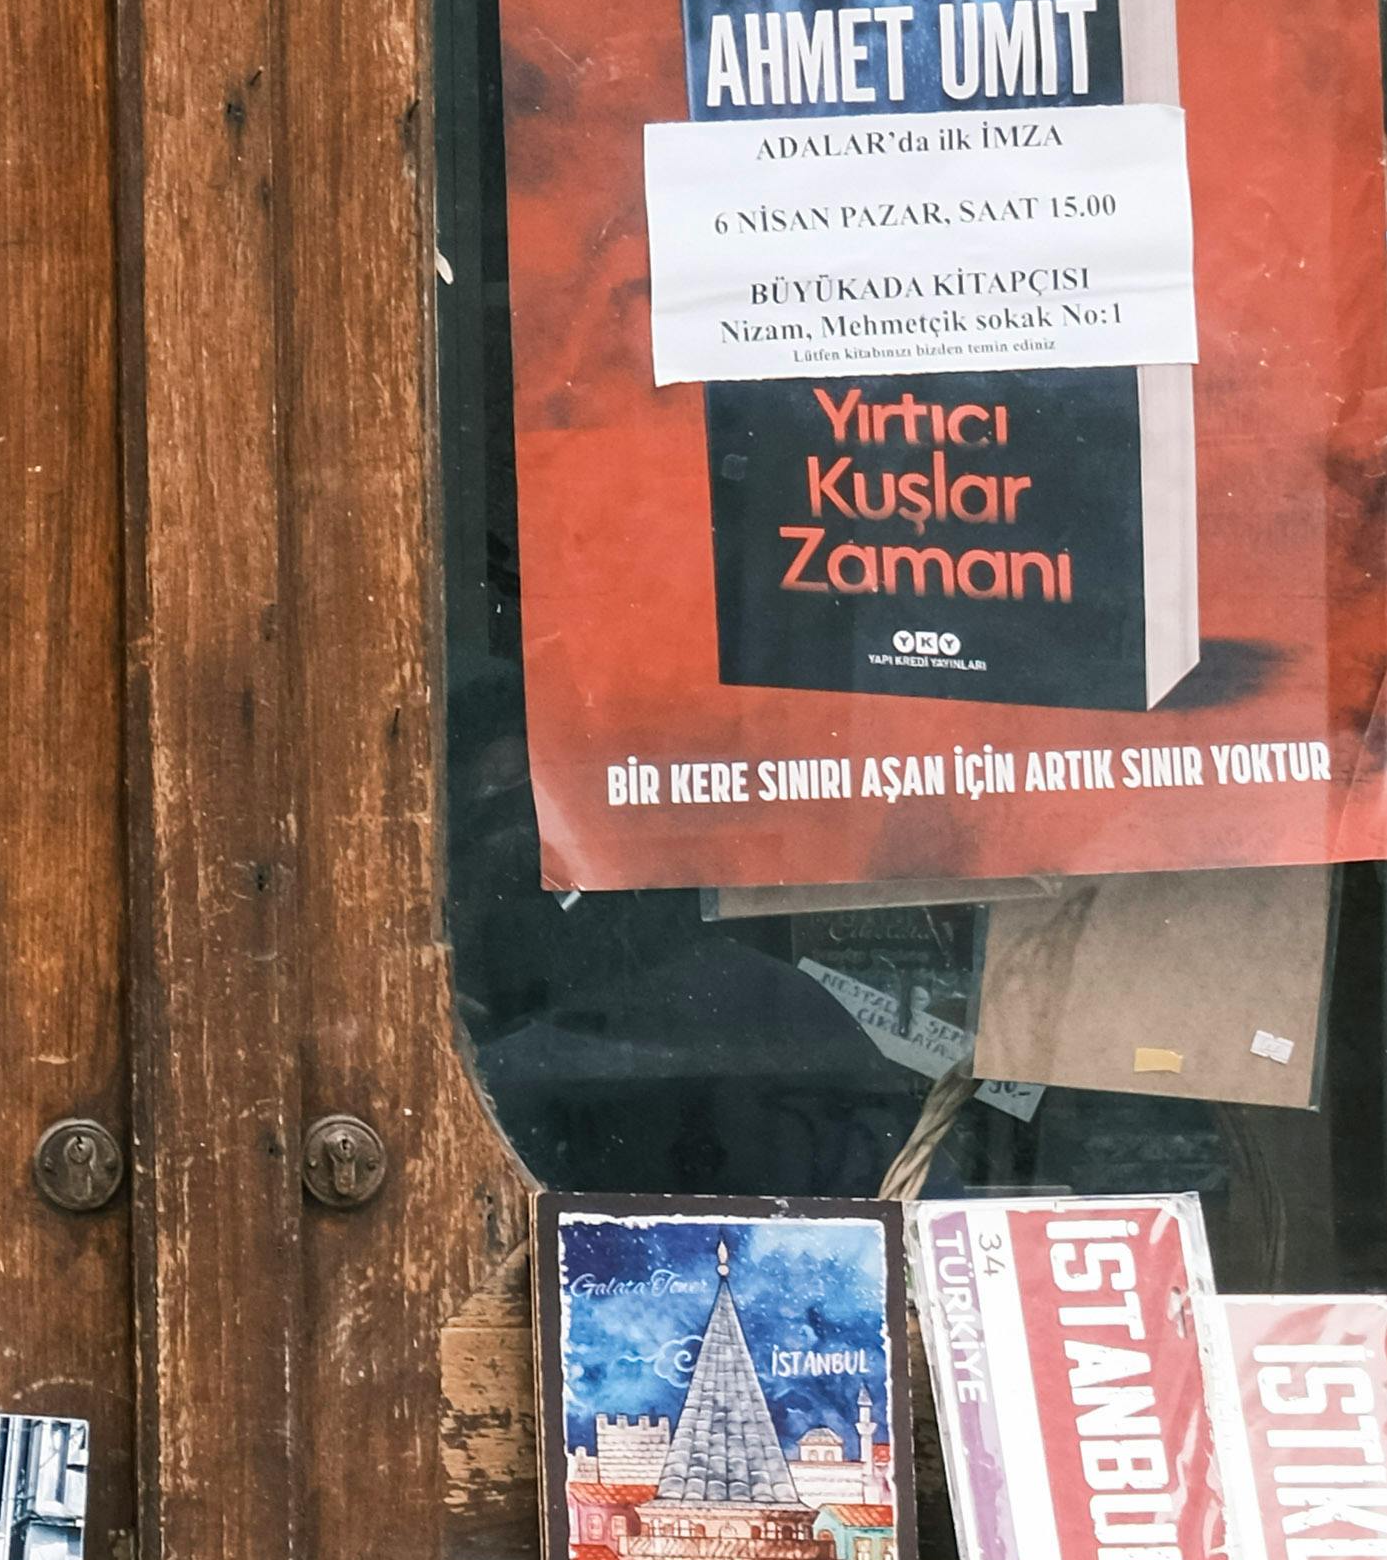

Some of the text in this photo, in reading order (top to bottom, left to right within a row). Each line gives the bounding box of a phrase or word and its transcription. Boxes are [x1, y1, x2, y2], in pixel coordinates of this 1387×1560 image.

[706, 6, 913, 107] AHMET
[757, 121, 1064, 161] ADALAR'da ilk İMZA
[714, 193, 1117, 235] 6 NİSAN PAZAR, SAAT 15.00
[750, 266, 1090, 306] BÜYÜKADA KİTAPÇISI
[721, 302, 1122, 346] Nizam, Mehmetçik sokak No:1
[793, 346, 840, 364] Lütfen
[916, 341, 963, 357] bizden
[967, 340, 1009, 354] temin
[1012, 337, 1056, 353] ediniz
[812, 388, 1009, 447] Yırtıcı
[806, 450, 1033, 536] Kuşlar
[779, 526, 1074, 604] Zamanı
[606, 740, 1332, 807] BİR KERE SINIRI AŞAN İÇİN ARTIK SINIR YOKTUR
[978, 1231, 1002, 1277] 34
[570, 1271, 649, 1299] Galata
[935, 1230, 988, 1404] TÜRKİYE
[771, 1343, 871, 1377] İSTANBUL
